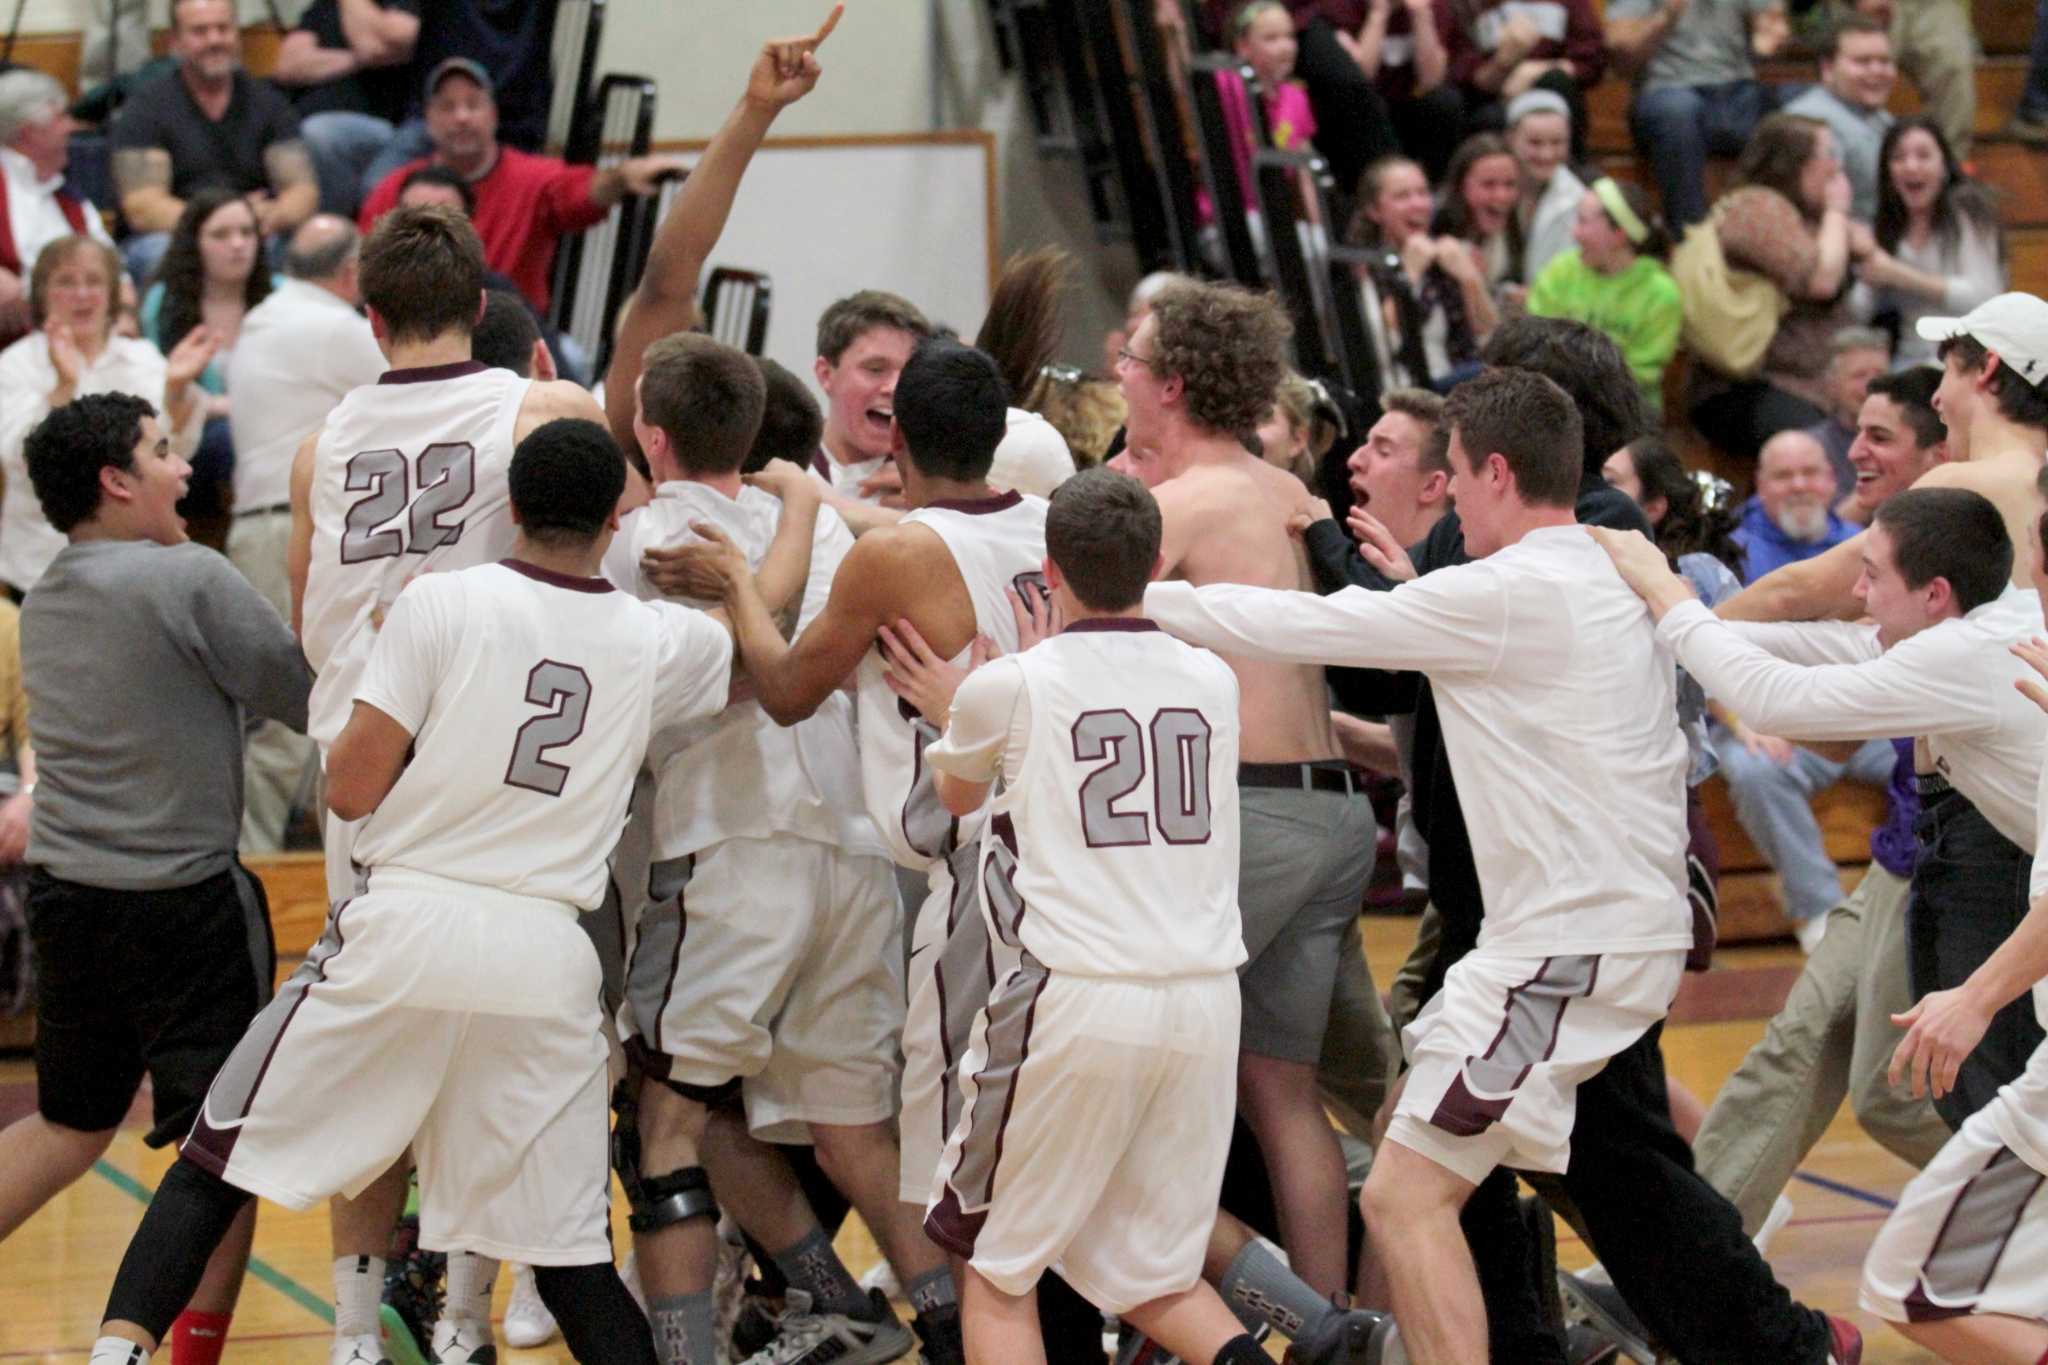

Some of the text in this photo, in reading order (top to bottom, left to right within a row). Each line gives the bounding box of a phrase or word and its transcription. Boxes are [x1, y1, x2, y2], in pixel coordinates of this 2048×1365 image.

[341, 441, 475, 565] 22
[504, 658, 592, 797] 2
[1070, 707, 1212, 848] 20
